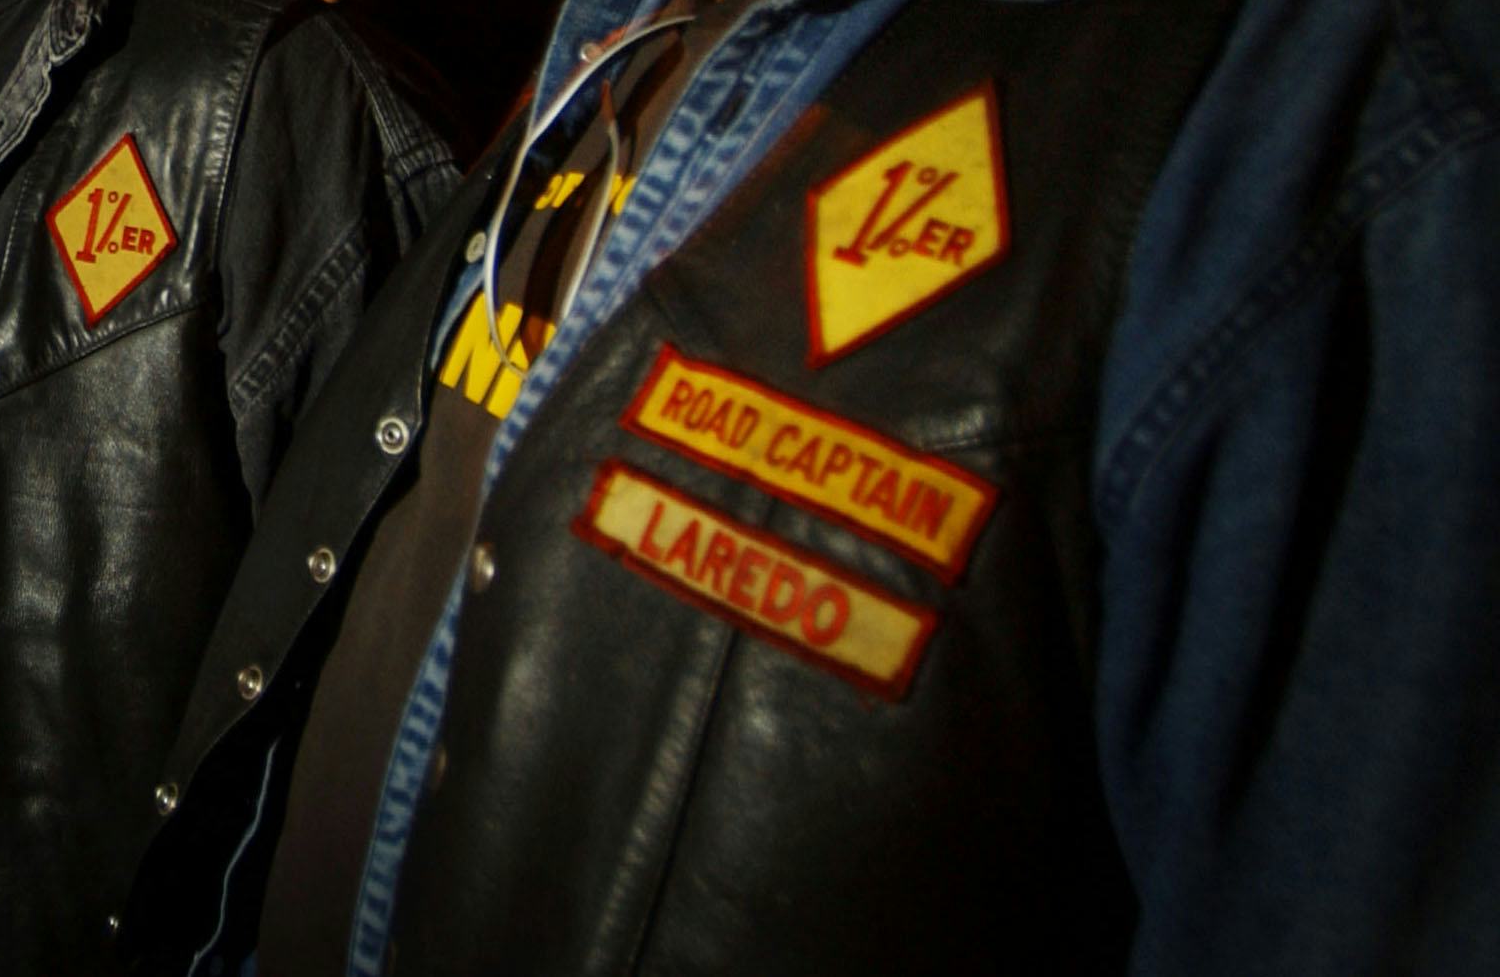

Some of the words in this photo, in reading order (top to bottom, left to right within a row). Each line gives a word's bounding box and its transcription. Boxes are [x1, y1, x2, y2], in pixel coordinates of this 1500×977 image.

[75, 188, 157, 264] 1%ER
[831, 158, 977, 270] 1%ER
[659, 378, 762, 458] ROAD
[765, 425, 956, 543] CAPTAIN
[638, 501, 851, 648] LAREDO
